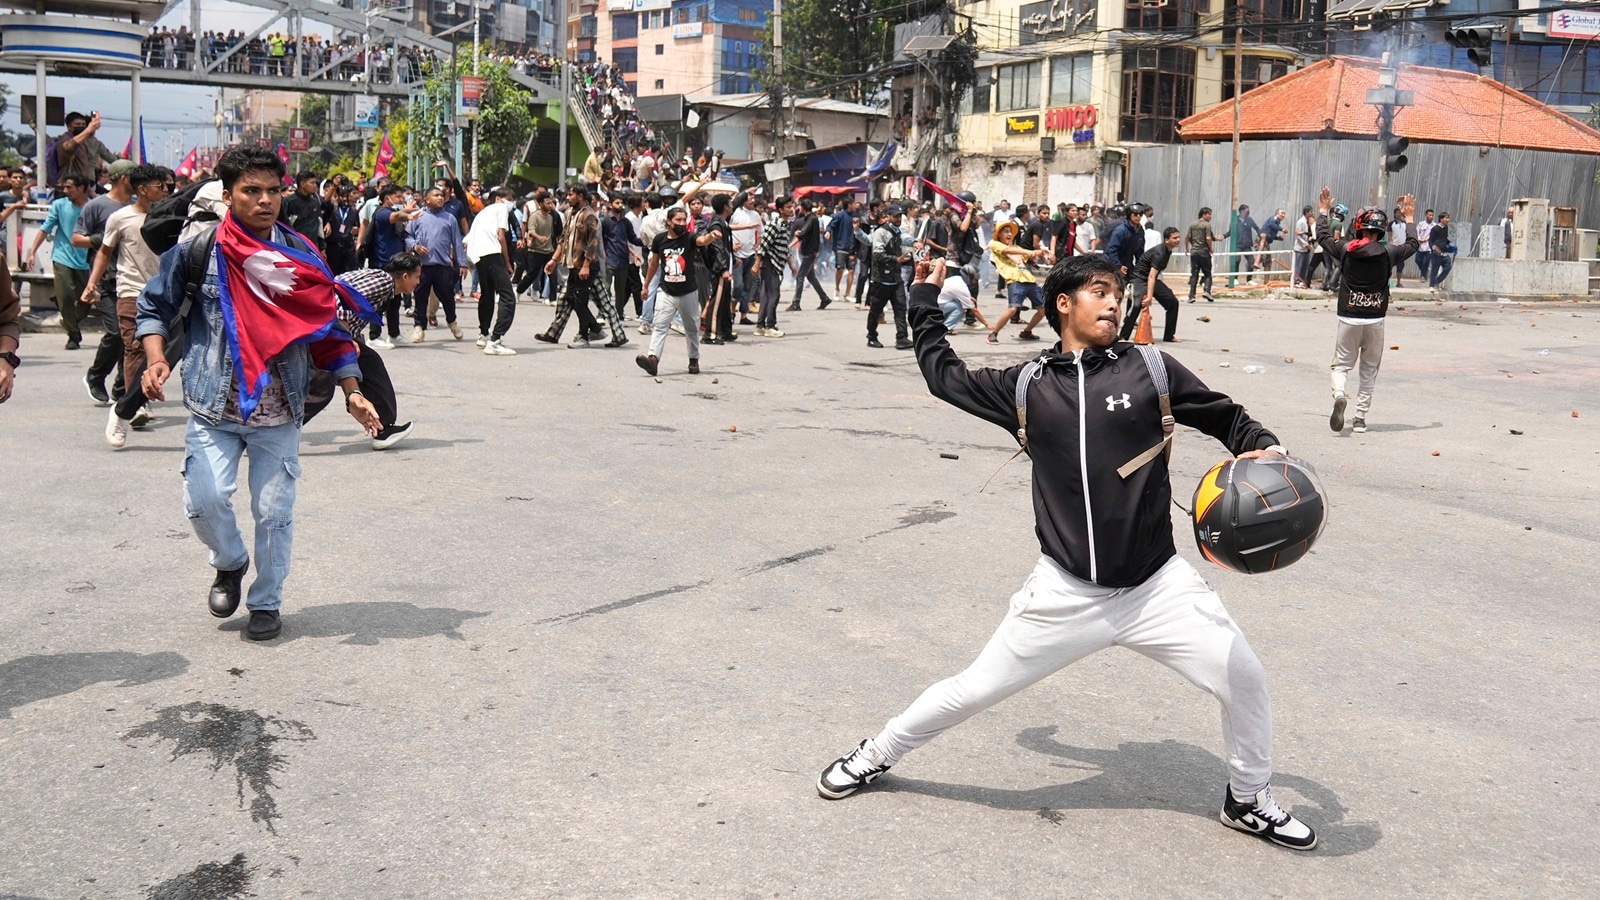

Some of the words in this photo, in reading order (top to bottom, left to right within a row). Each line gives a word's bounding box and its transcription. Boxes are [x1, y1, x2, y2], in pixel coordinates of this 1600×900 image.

[1572, 16, 1596, 24] Global
[1045, 104, 1096, 129] AMIGO
[1072, 130, 1095, 143] CAFE
